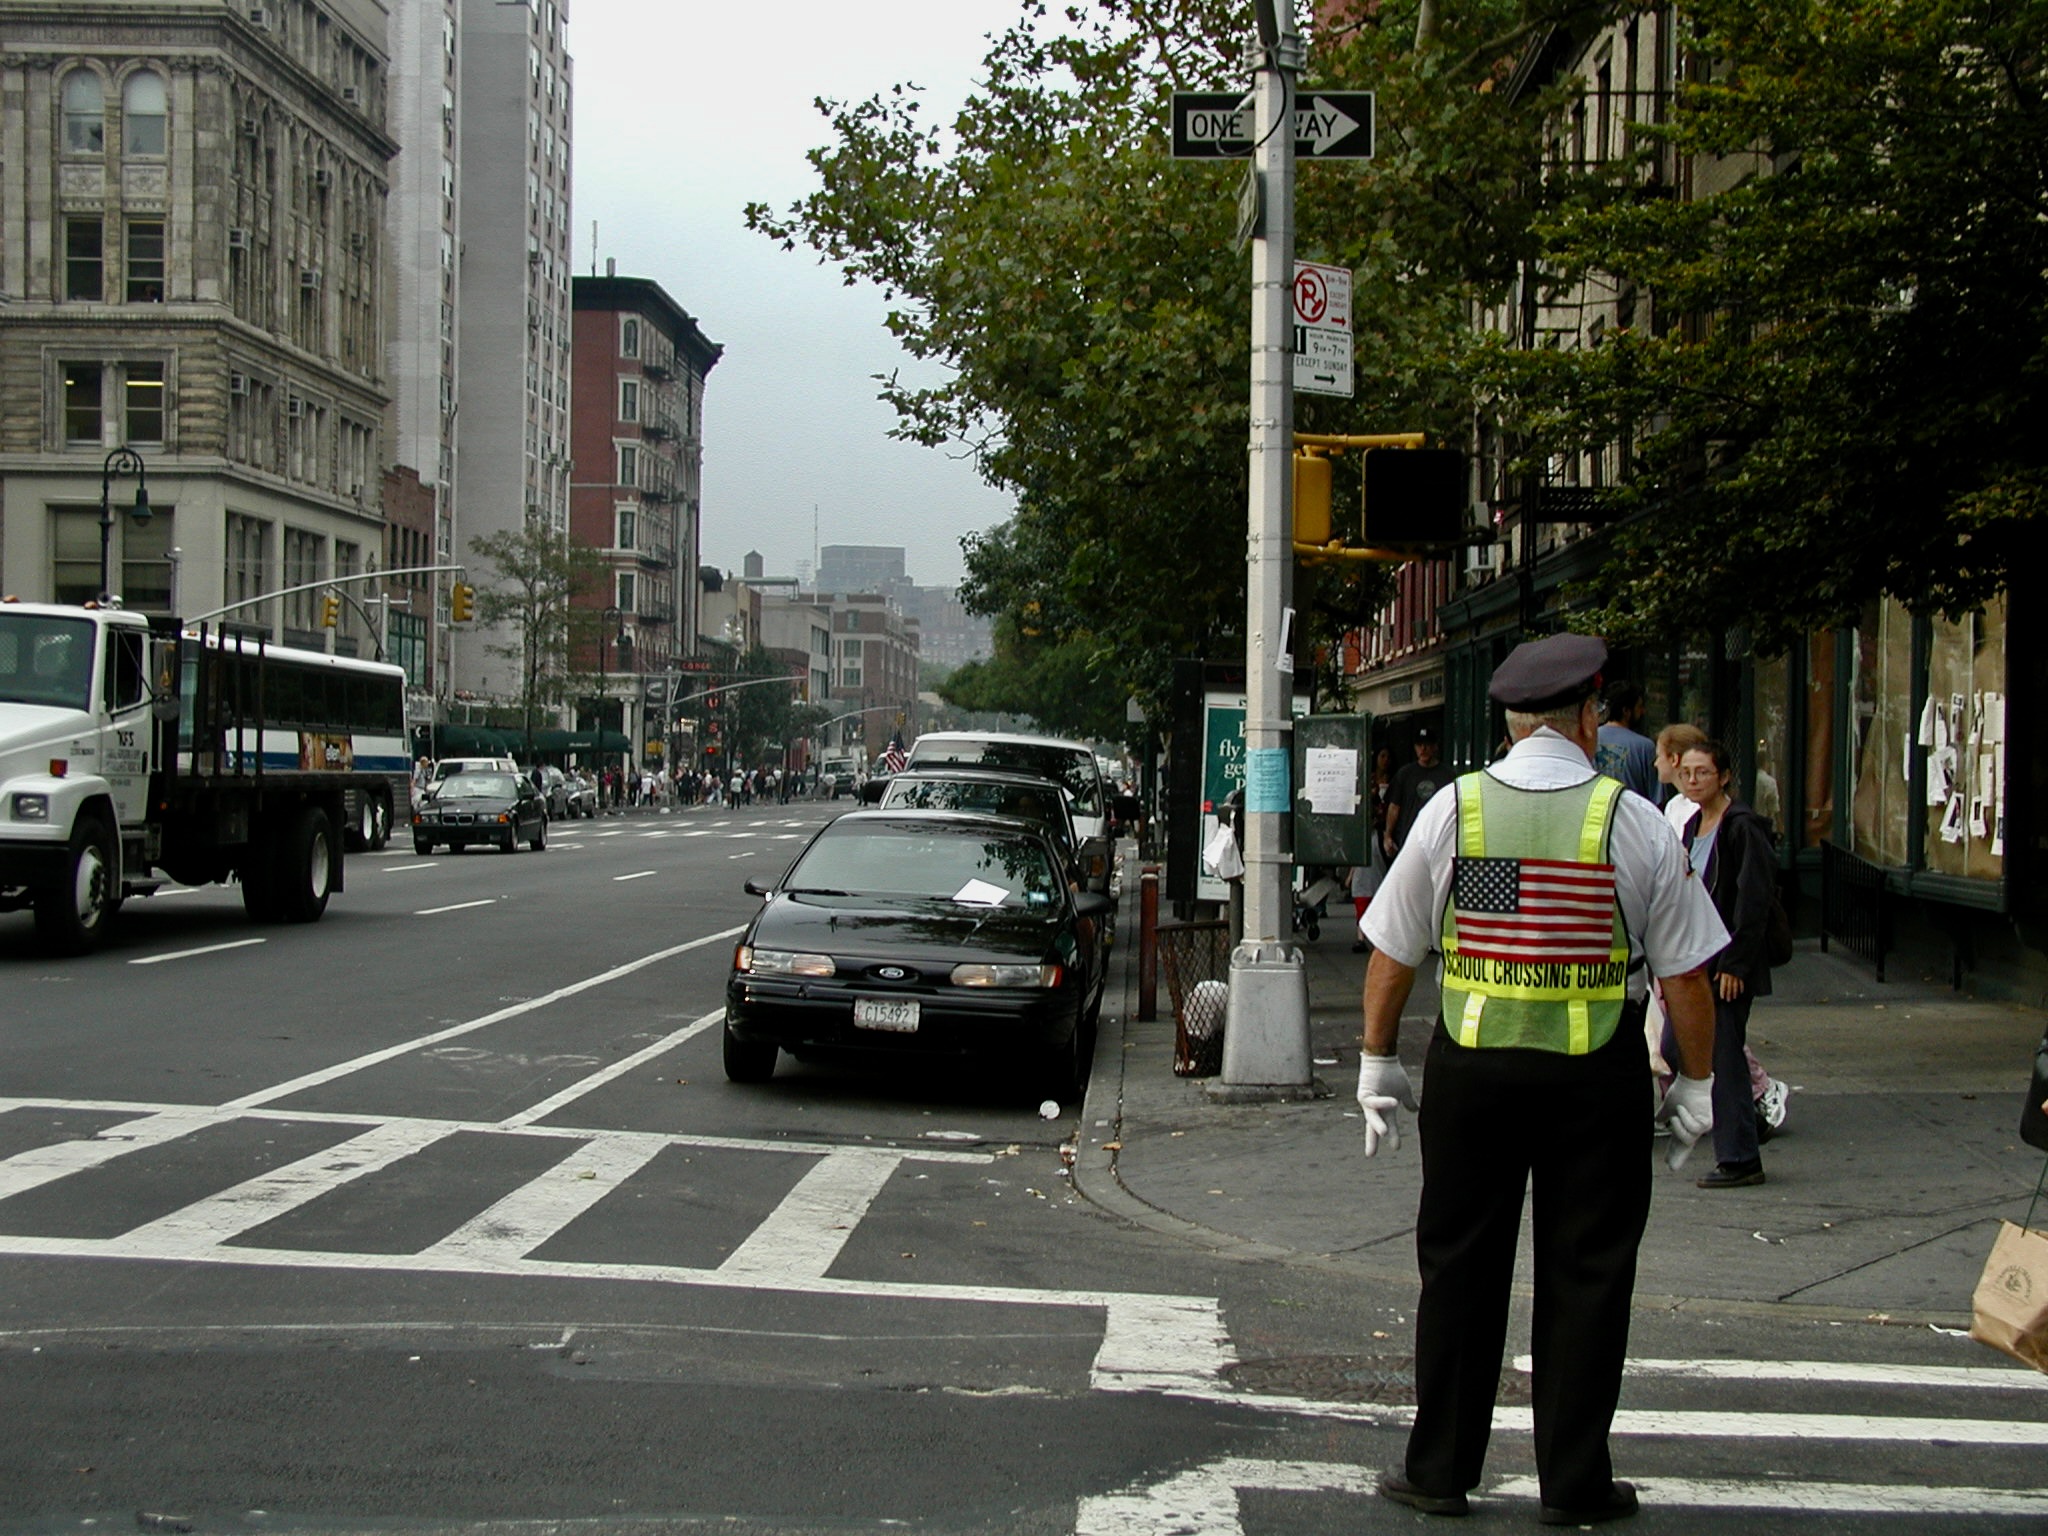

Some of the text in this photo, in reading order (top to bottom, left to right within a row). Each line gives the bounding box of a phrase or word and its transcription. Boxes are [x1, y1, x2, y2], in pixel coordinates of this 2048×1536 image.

[1192, 113, 1244, 138] ONE
[1296, 356, 1348, 373] EXCEPT SUNDAY
[1219, 738, 1241, 761] fly
[1446, 950, 1625, 989] SCHOOL CROSSING GUARD
